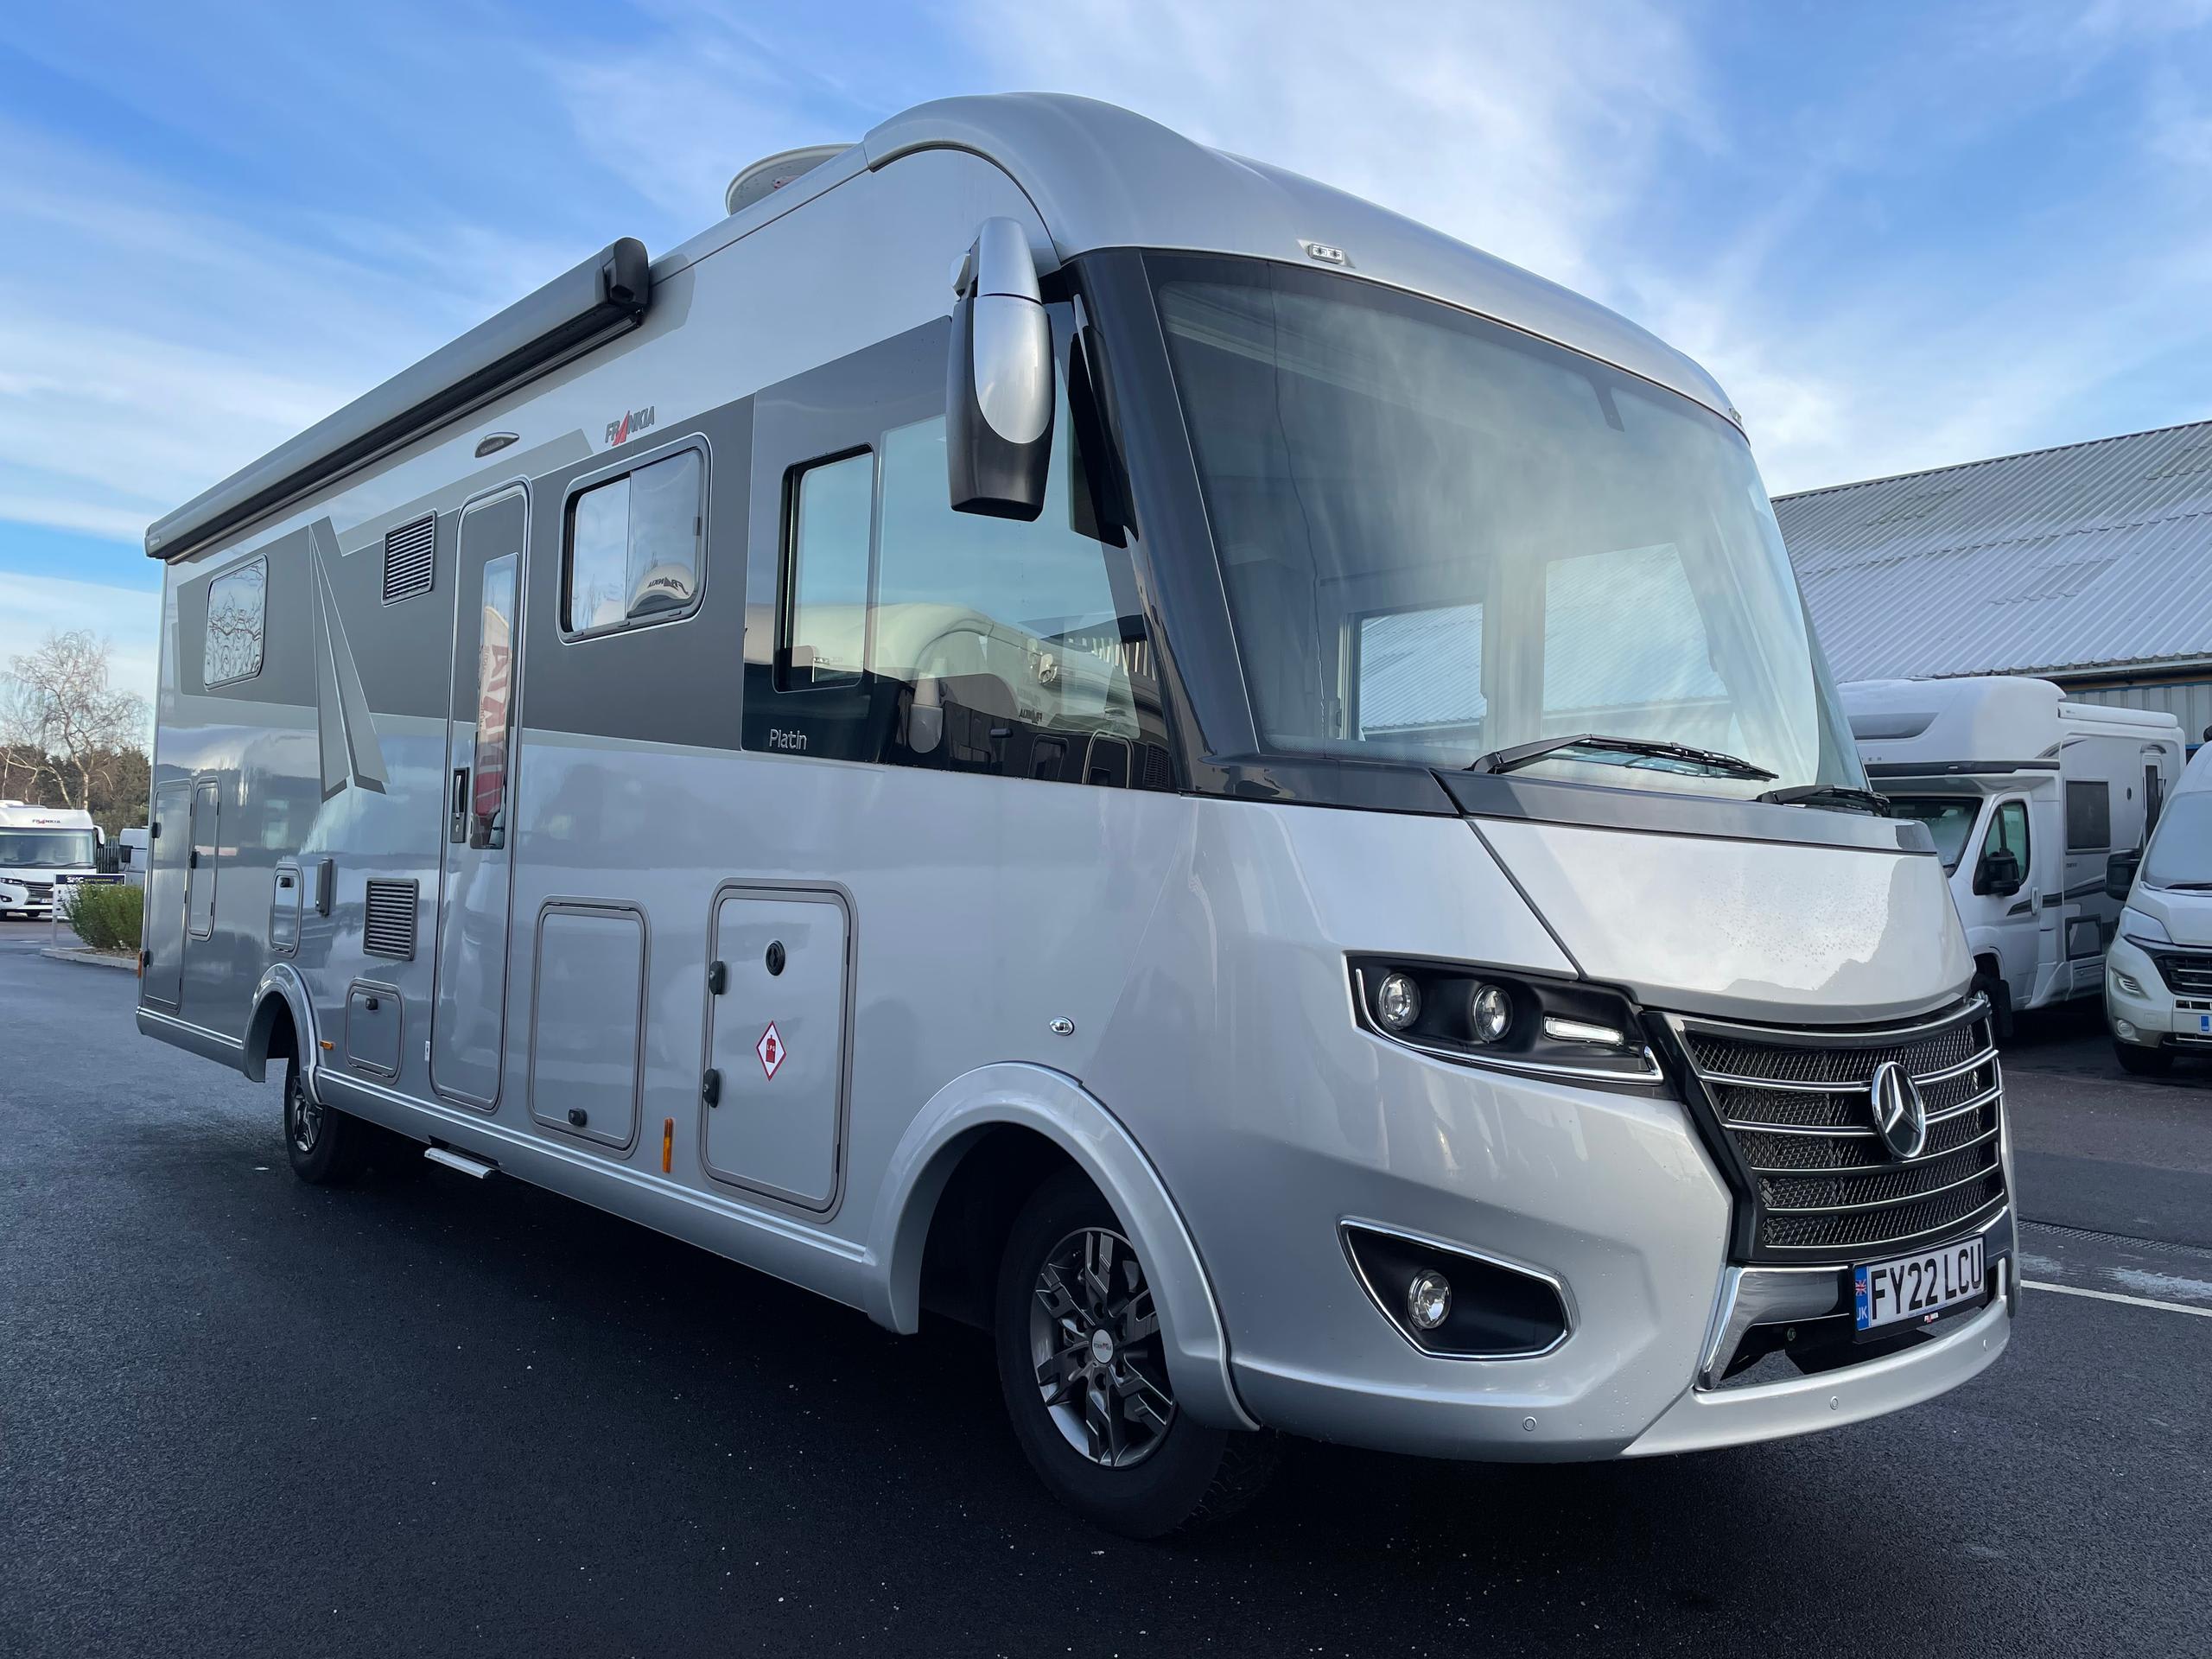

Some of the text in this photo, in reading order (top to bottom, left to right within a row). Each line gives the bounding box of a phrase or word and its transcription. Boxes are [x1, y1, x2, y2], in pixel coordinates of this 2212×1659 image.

[605, 406, 655, 447] FRANKIA
[769, 728, 807, 750] Platin
[1871, 1243, 1982, 1320] FY22 LCU
